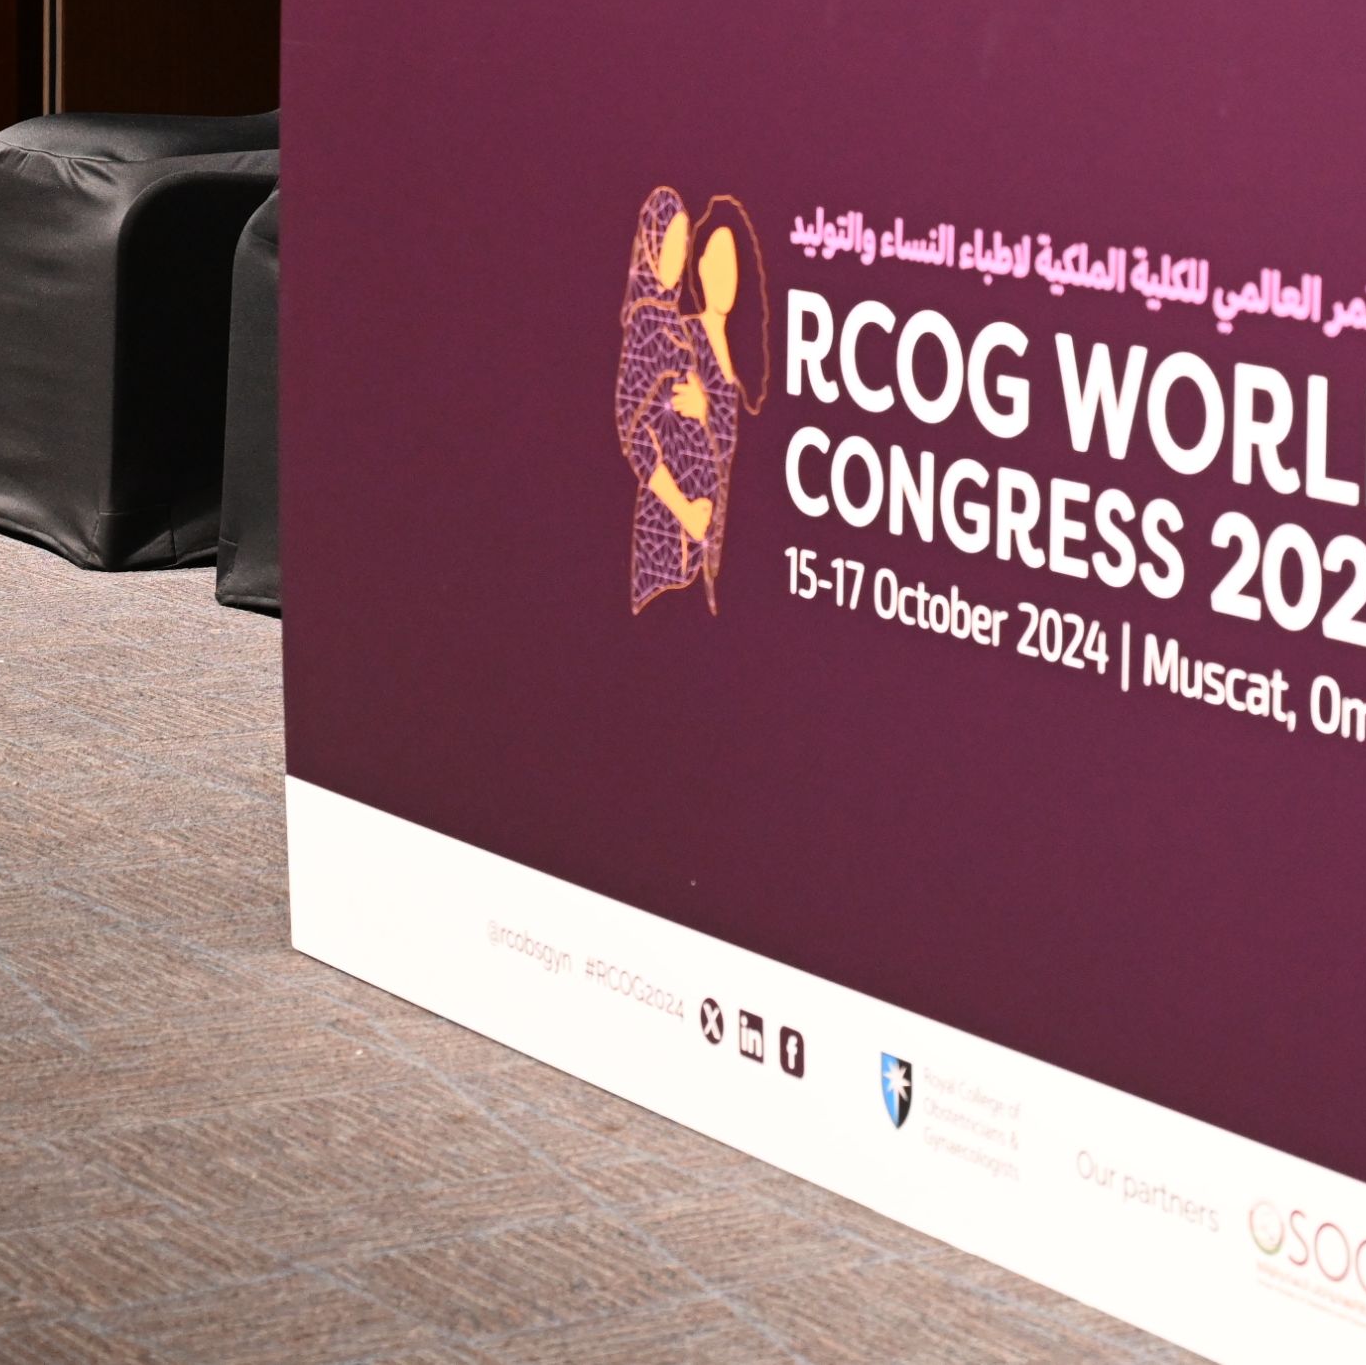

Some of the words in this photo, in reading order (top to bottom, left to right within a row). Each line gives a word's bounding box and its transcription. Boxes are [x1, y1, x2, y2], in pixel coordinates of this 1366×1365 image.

[790, 206, 876, 266] والتوليد
[880, 217, 955, 267] النساء
[1035, 233, 1126, 296] الملكية
[1130, 246, 1209, 312] للكلية
[1212, 267, 1322, 335] العالمي
[786, 288, 1030, 439] RCOG
[785, 426, 1185, 599] CONGRESS
[785, 546, 865, 610] 15-17
[874, 568, 1008, 647] October
[1017, 601, 1109, 674] 2024
[1143, 633, 1296, 733] Muscat,
[487, 920, 572, 974] @rcobsgyn
[585, 956, 685, 1022] #RCOG2024
[741, 1015, 763, 1057] in
[1077, 1150, 1115, 1188] Our
[1123, 1175, 1219, 1233] partners
